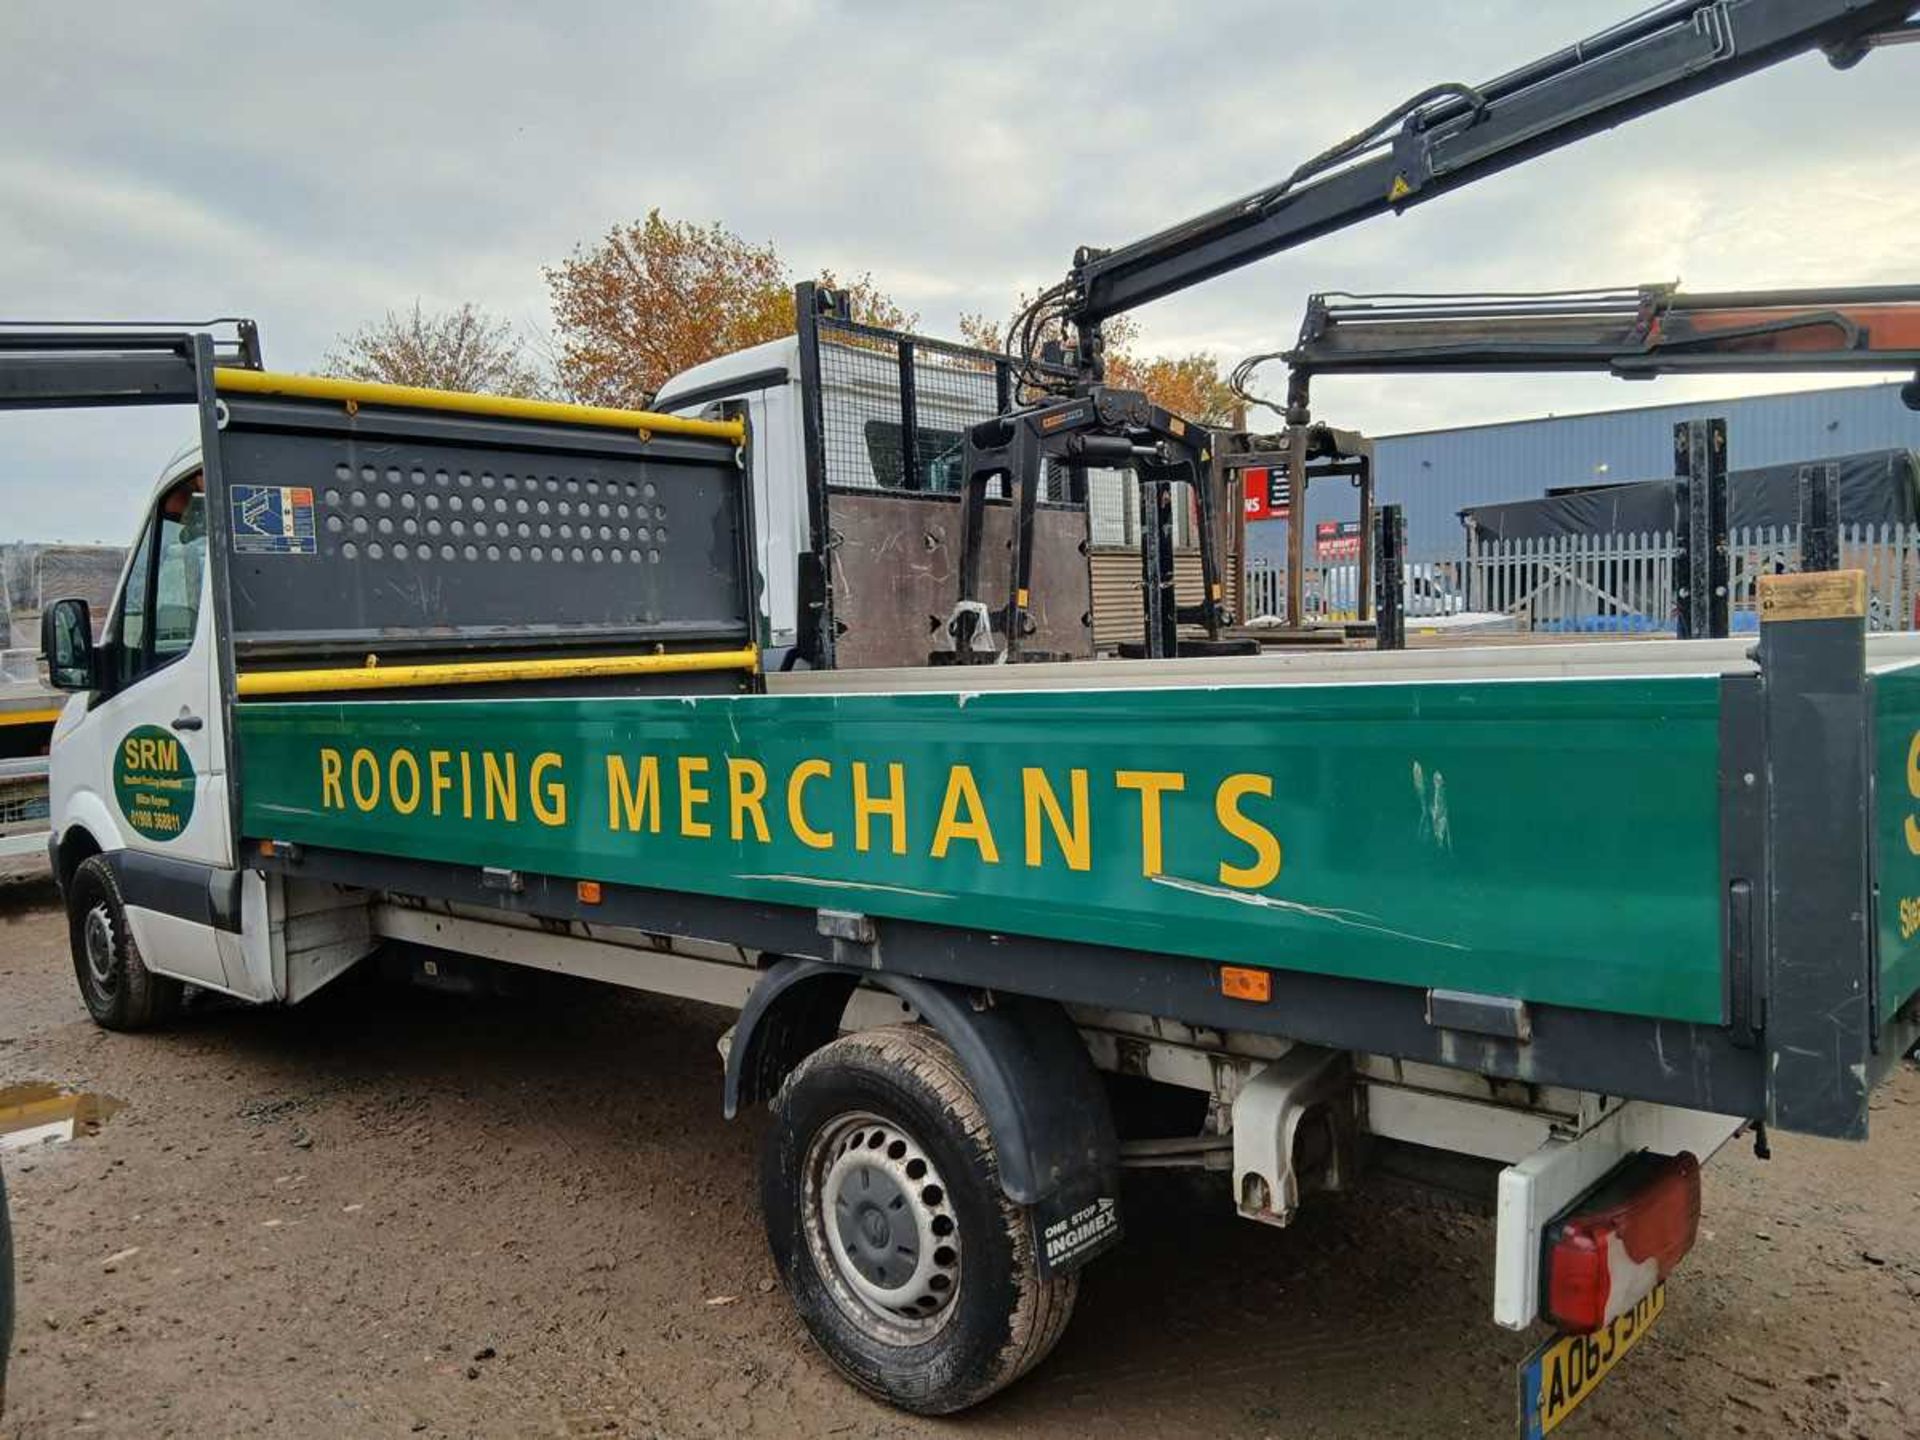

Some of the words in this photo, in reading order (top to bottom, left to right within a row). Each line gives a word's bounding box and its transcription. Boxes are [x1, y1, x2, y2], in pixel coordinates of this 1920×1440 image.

[125, 738, 178, 771] SRM
[320, 748, 567, 827] ROOFING
[606, 754, 1282, 889] MERCHANTS
[1044, 1219, 1068, 1239] ONE
[1071, 1204, 1097, 1226] STOP
[1046, 1207, 1116, 1258] INGIMEX
